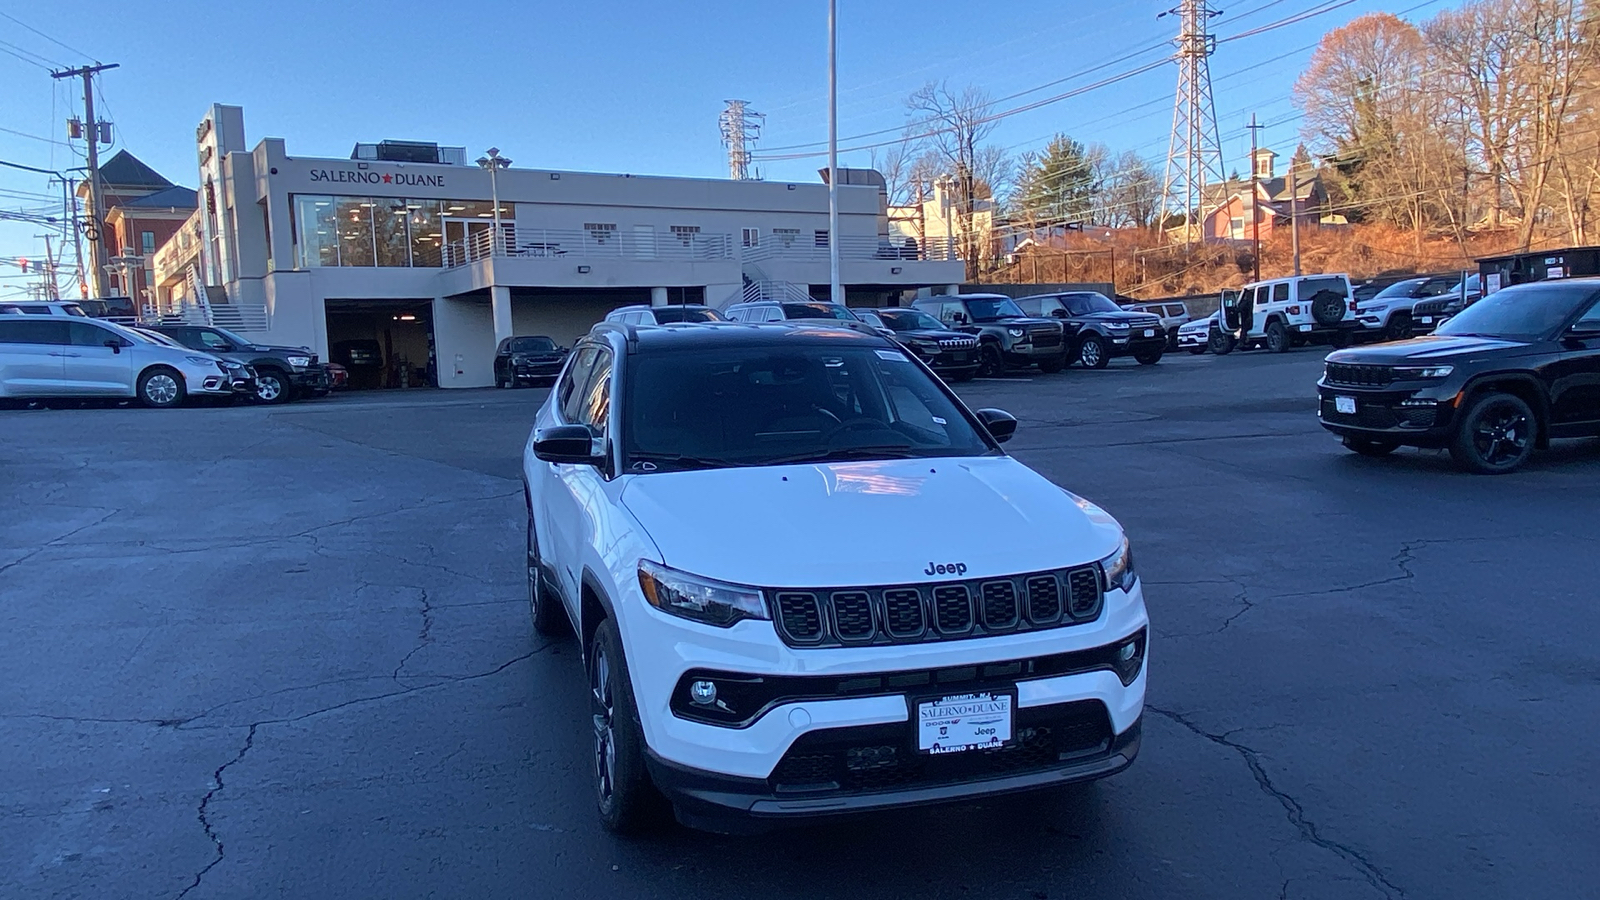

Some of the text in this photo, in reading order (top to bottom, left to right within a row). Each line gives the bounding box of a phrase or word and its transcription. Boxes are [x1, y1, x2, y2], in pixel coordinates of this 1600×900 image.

[310, 170, 445, 187] SALERNO DUANE
[924, 561, 967, 576] Jeep
[921, 705, 967, 718] SALERNO
[973, 702, 1008, 712] DUANE
[974, 727, 996, 736] Jeep
[929, 740, 1004, 755] SALERNO DUANE
